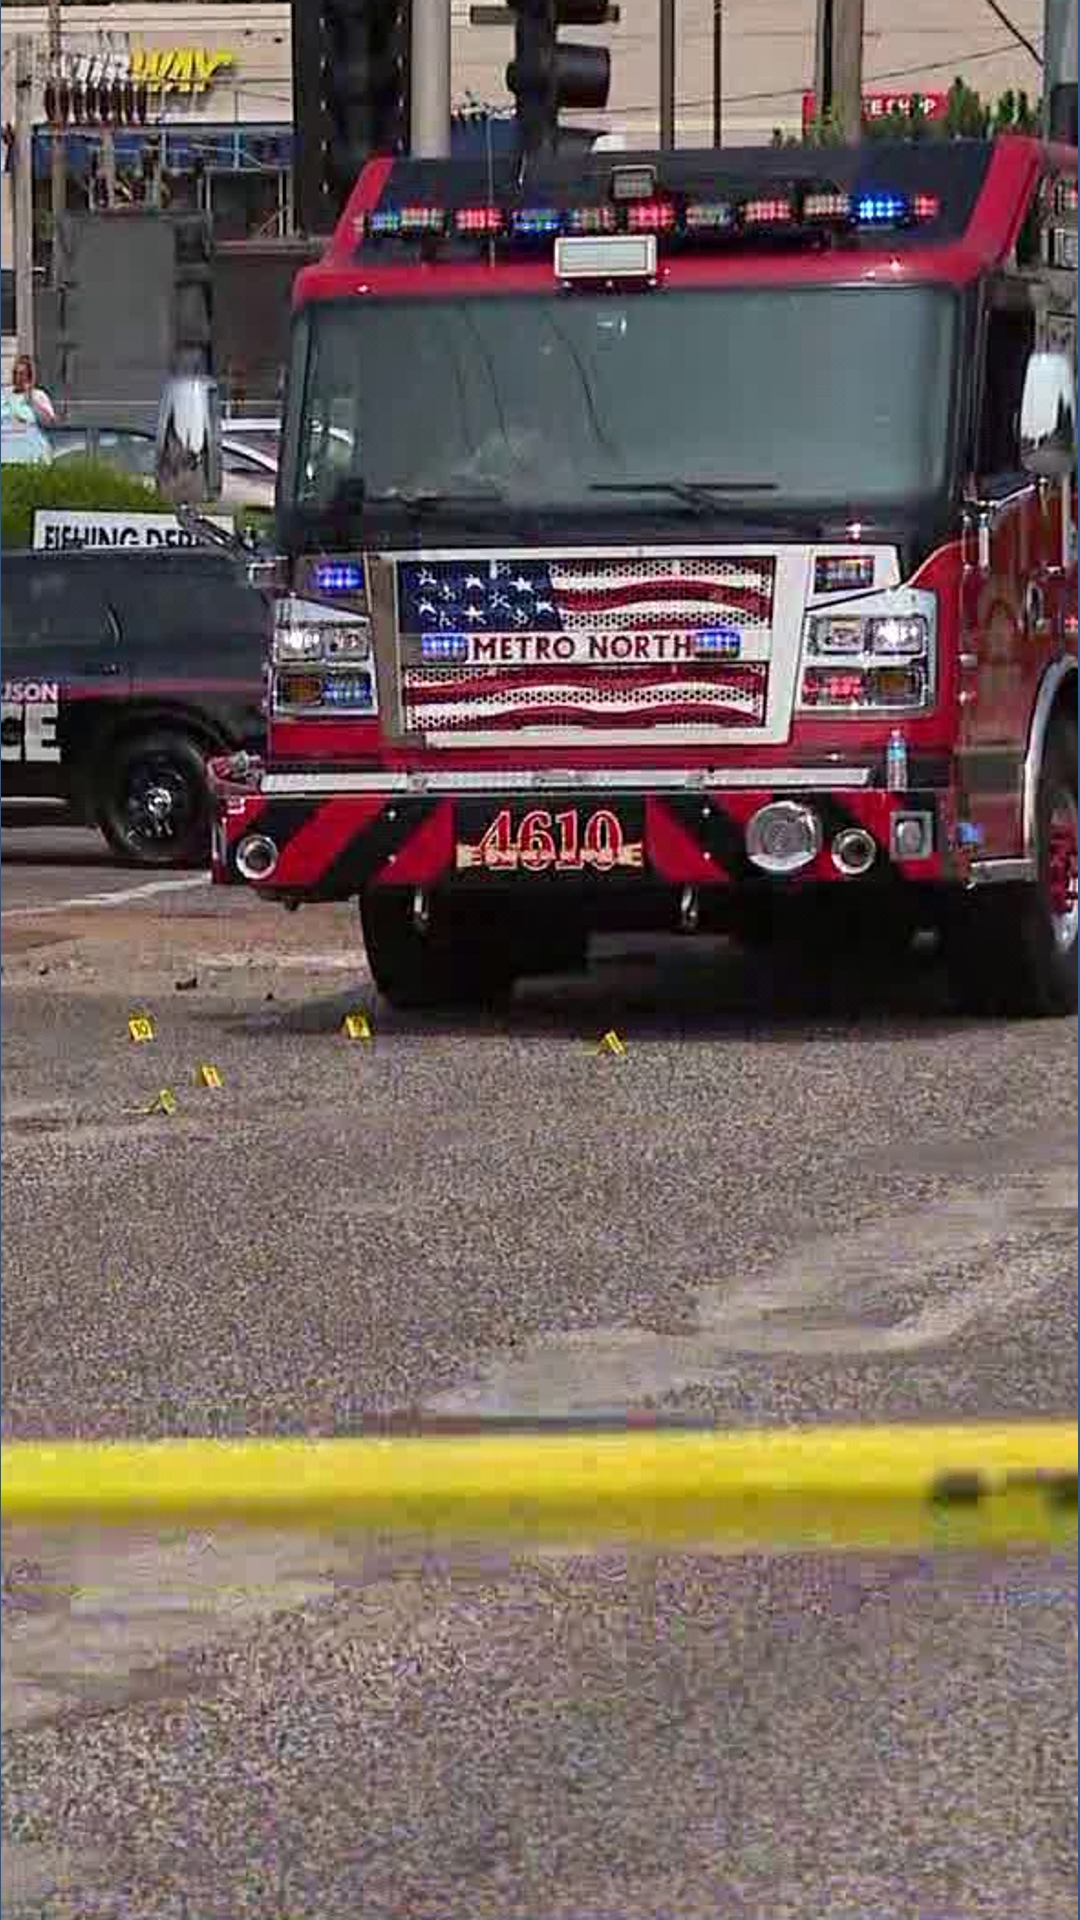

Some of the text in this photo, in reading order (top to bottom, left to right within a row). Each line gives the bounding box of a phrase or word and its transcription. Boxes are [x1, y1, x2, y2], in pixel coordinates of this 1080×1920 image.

[48, 46, 232, 93] WAY
[146, 528, 206, 547] DEP
[472, 635, 692, 660] METRO NORTH
[479, 810, 623, 871] 4610
